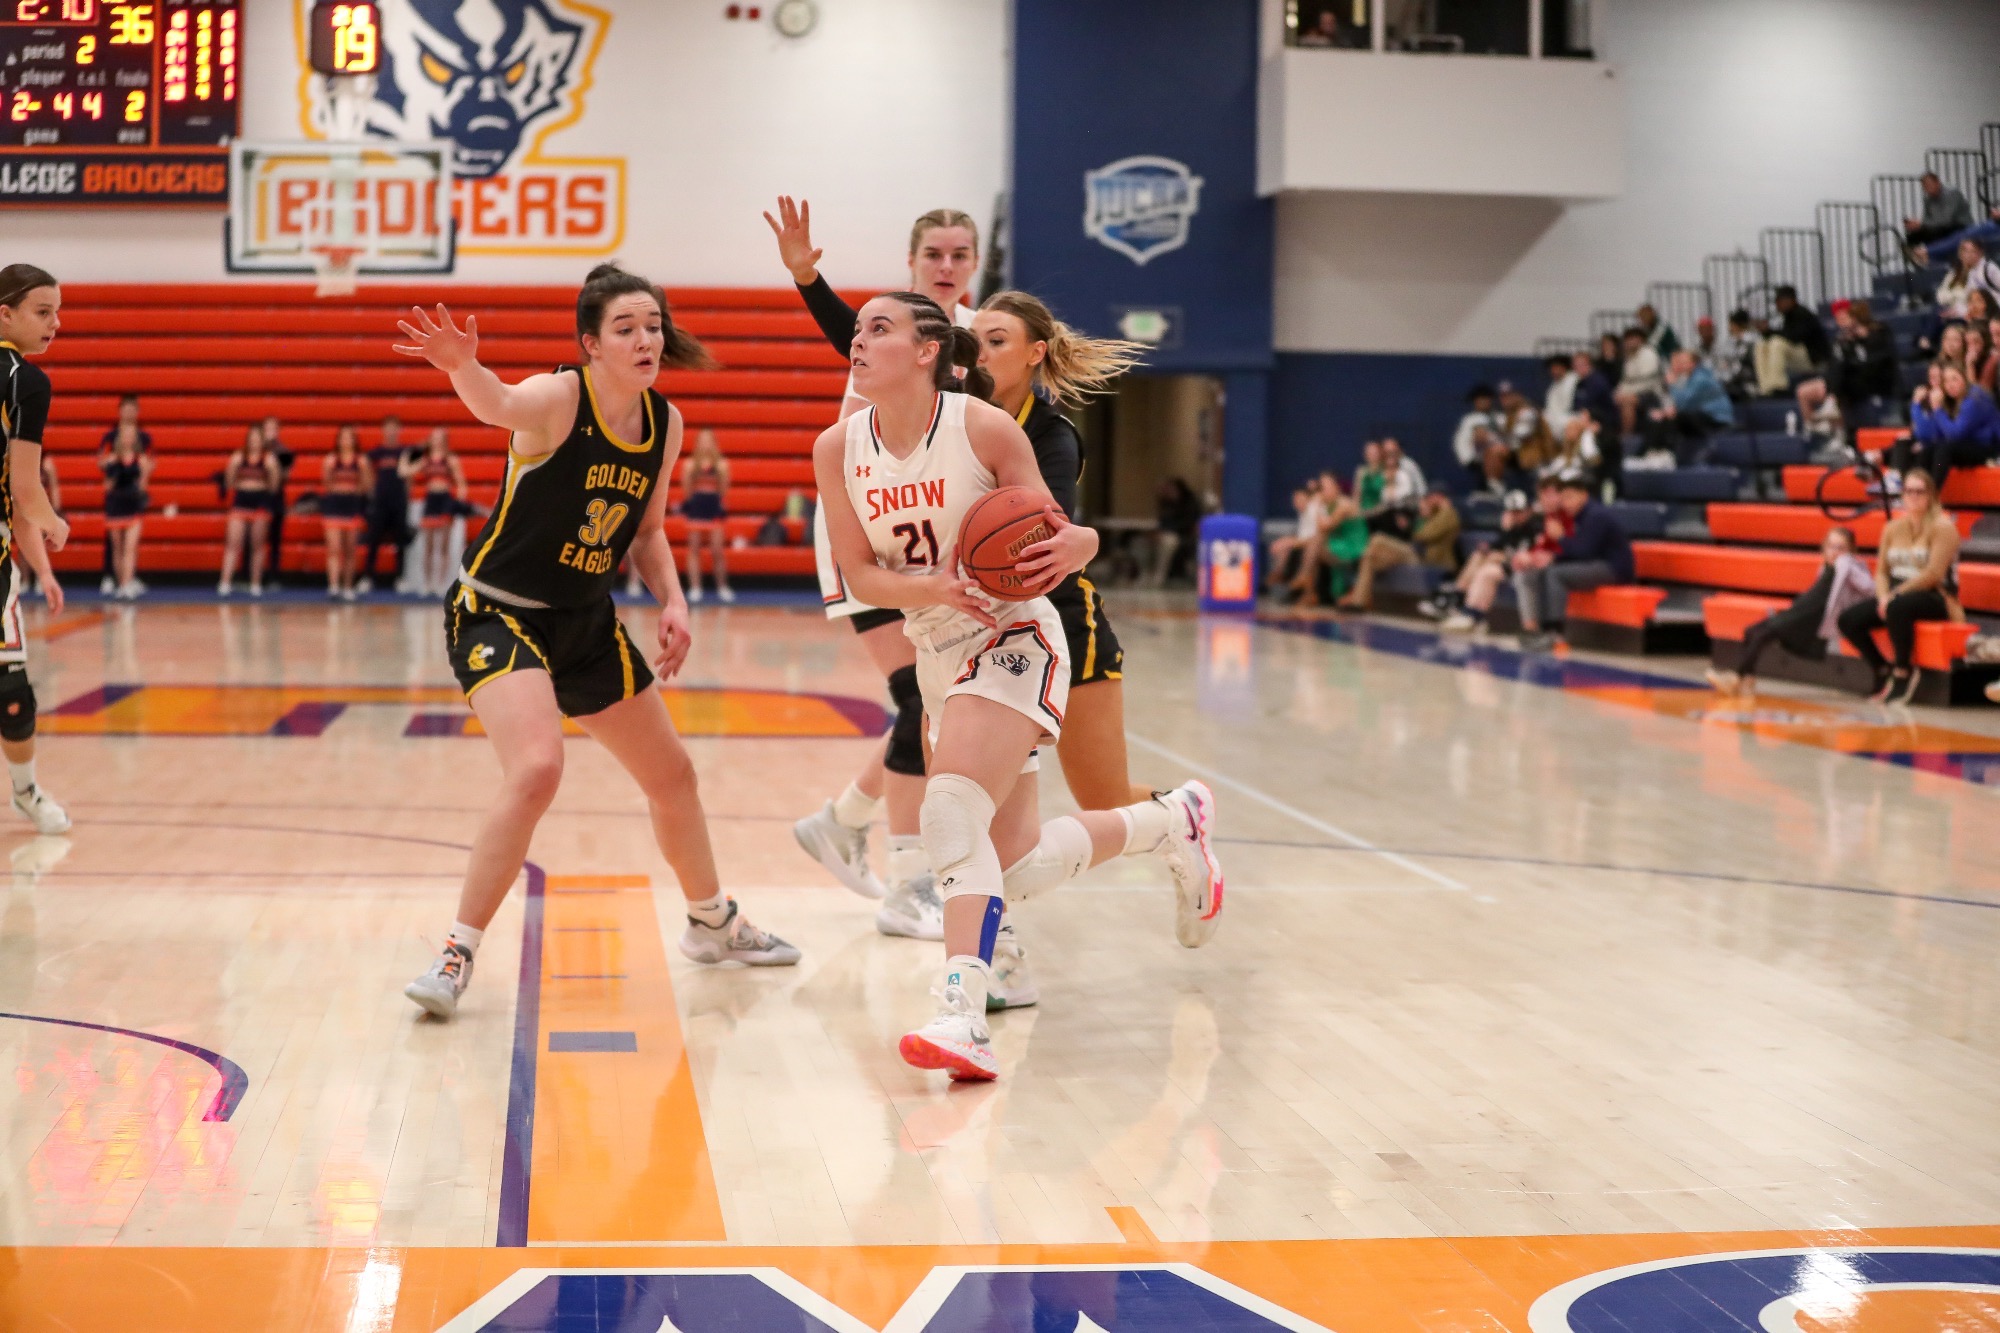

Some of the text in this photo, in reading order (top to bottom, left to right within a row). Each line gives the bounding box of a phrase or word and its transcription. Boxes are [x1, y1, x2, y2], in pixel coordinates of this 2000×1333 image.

[109, 5, 155, 44] 36
[76, 35, 97, 65] 2
[334, 26, 377, 72] 19
[125, 90, 146, 122] 2
[82, 163, 226, 194] BADGERS
[585, 464, 650, 500] GOLDEN
[866, 478, 945, 521] SNOW
[578, 498, 629, 546] 30
[892, 519, 939, 567] 21
